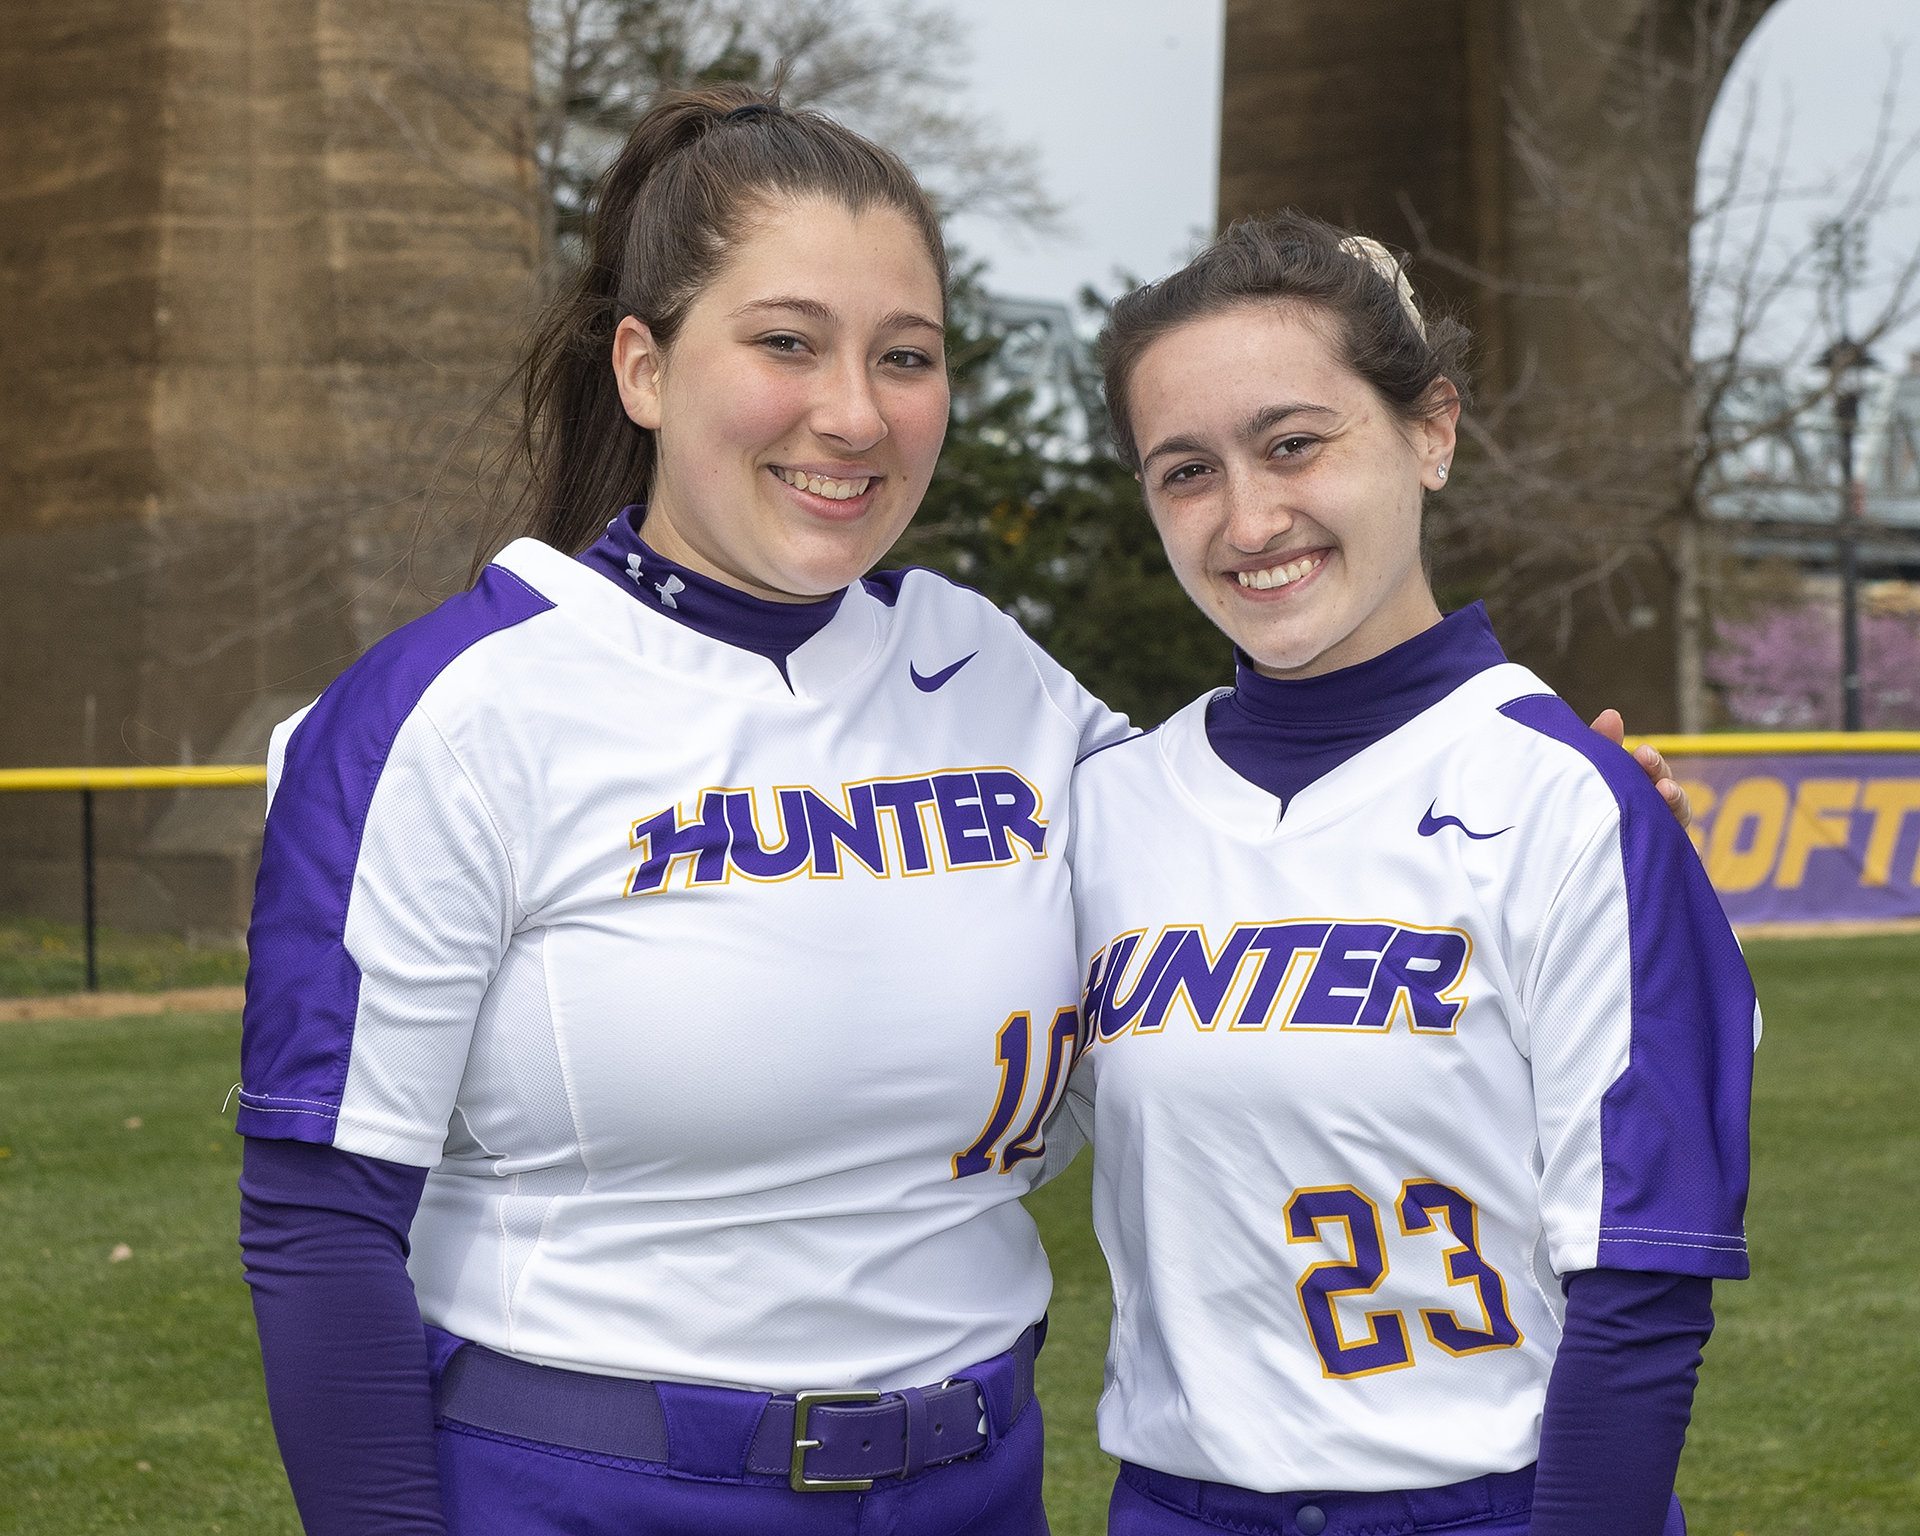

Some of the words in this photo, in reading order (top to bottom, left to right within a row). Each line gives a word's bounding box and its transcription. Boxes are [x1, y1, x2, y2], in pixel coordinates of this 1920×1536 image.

[623, 766, 1049, 898] HUNTER
[1674, 776, 1920, 893] OFT
[1074, 918, 1473, 1068] HUNTER
[1282, 1178, 1525, 1380] 23
